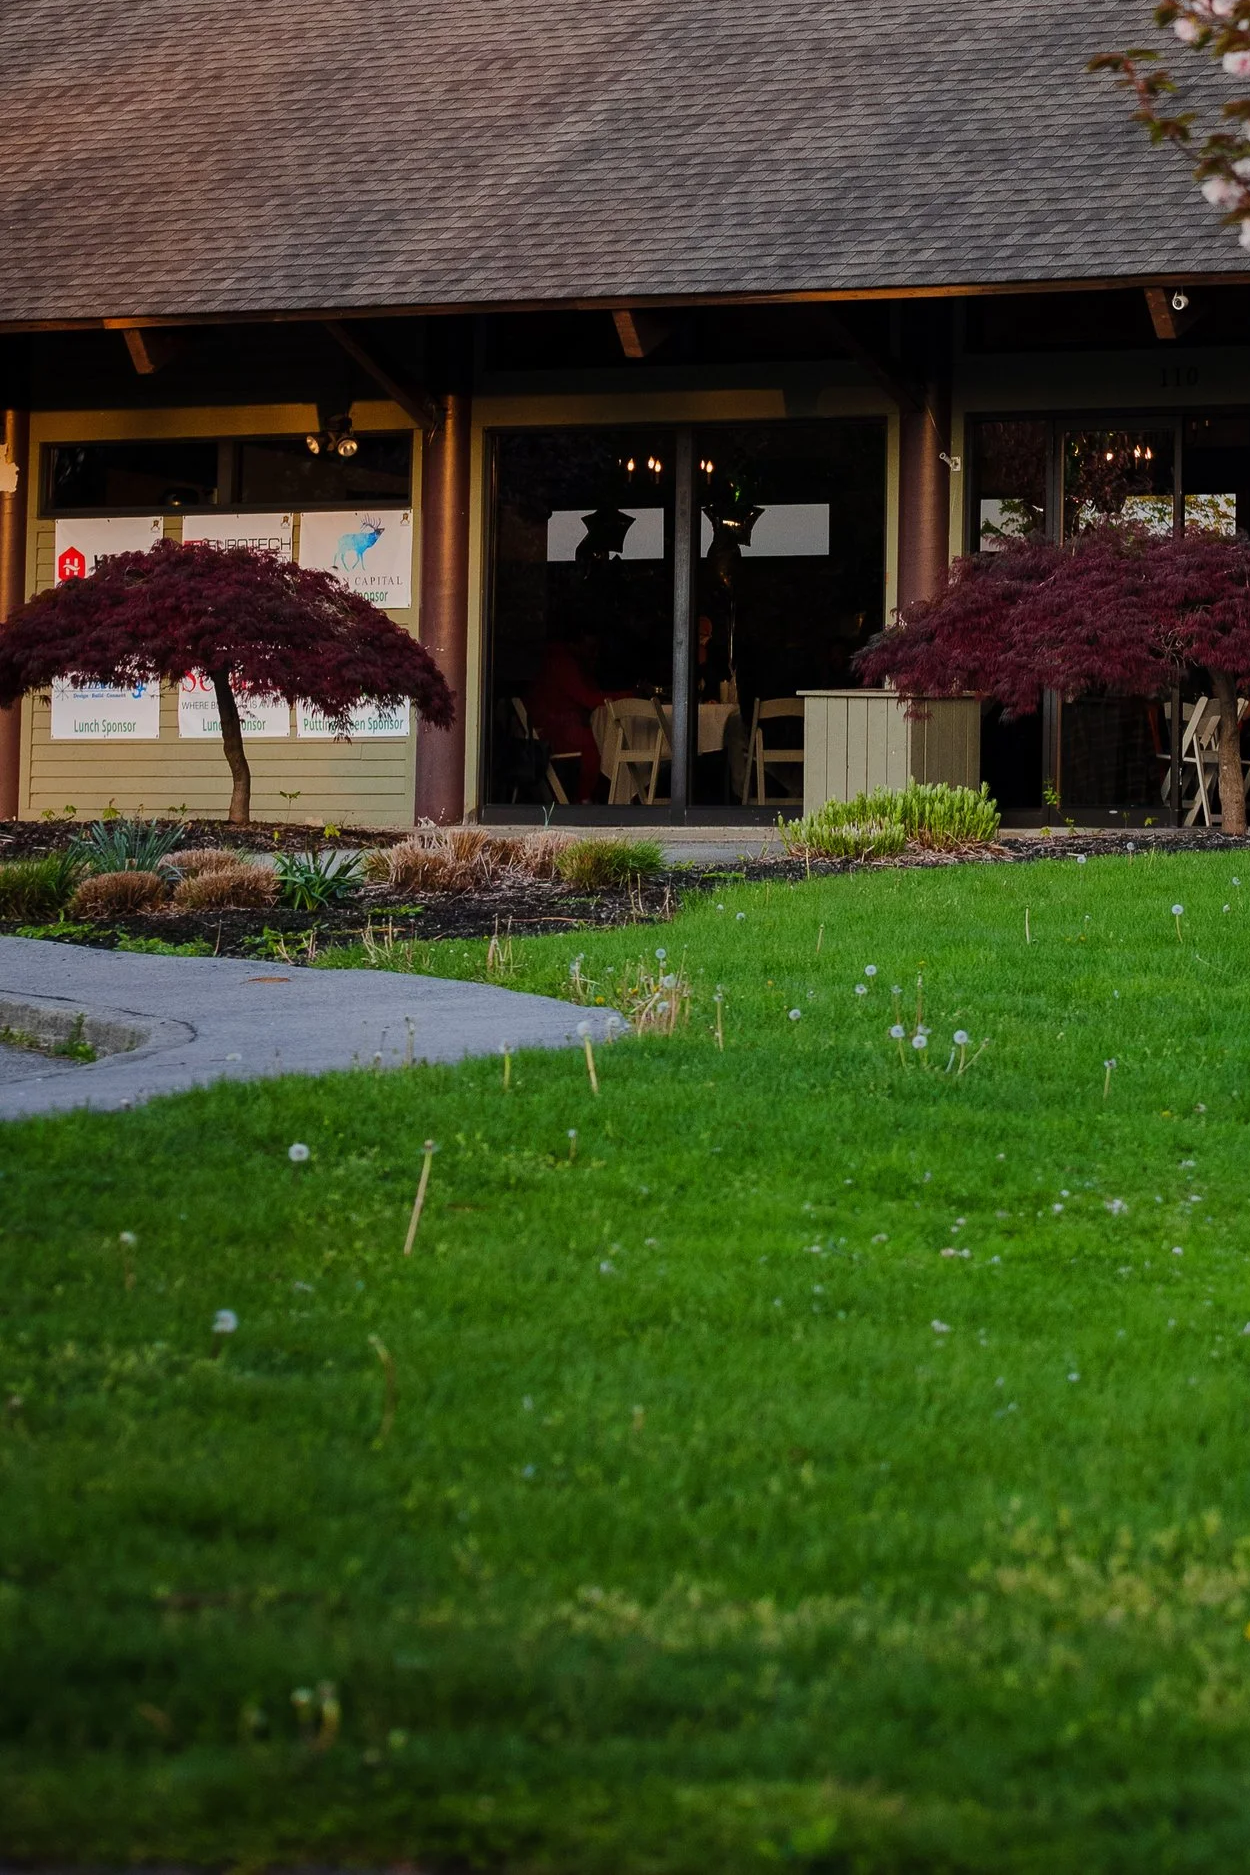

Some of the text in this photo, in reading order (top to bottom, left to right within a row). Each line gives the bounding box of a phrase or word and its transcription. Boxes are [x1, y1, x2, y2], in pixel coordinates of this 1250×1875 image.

[1160, 366, 1199, 387] 110
[354, 576, 403, 586] CAPITAL
[181, 701, 209, 710] WHERE
[74, 719, 137, 736] Lunch Sponsor
[368, 717, 404, 733] Sponsor
